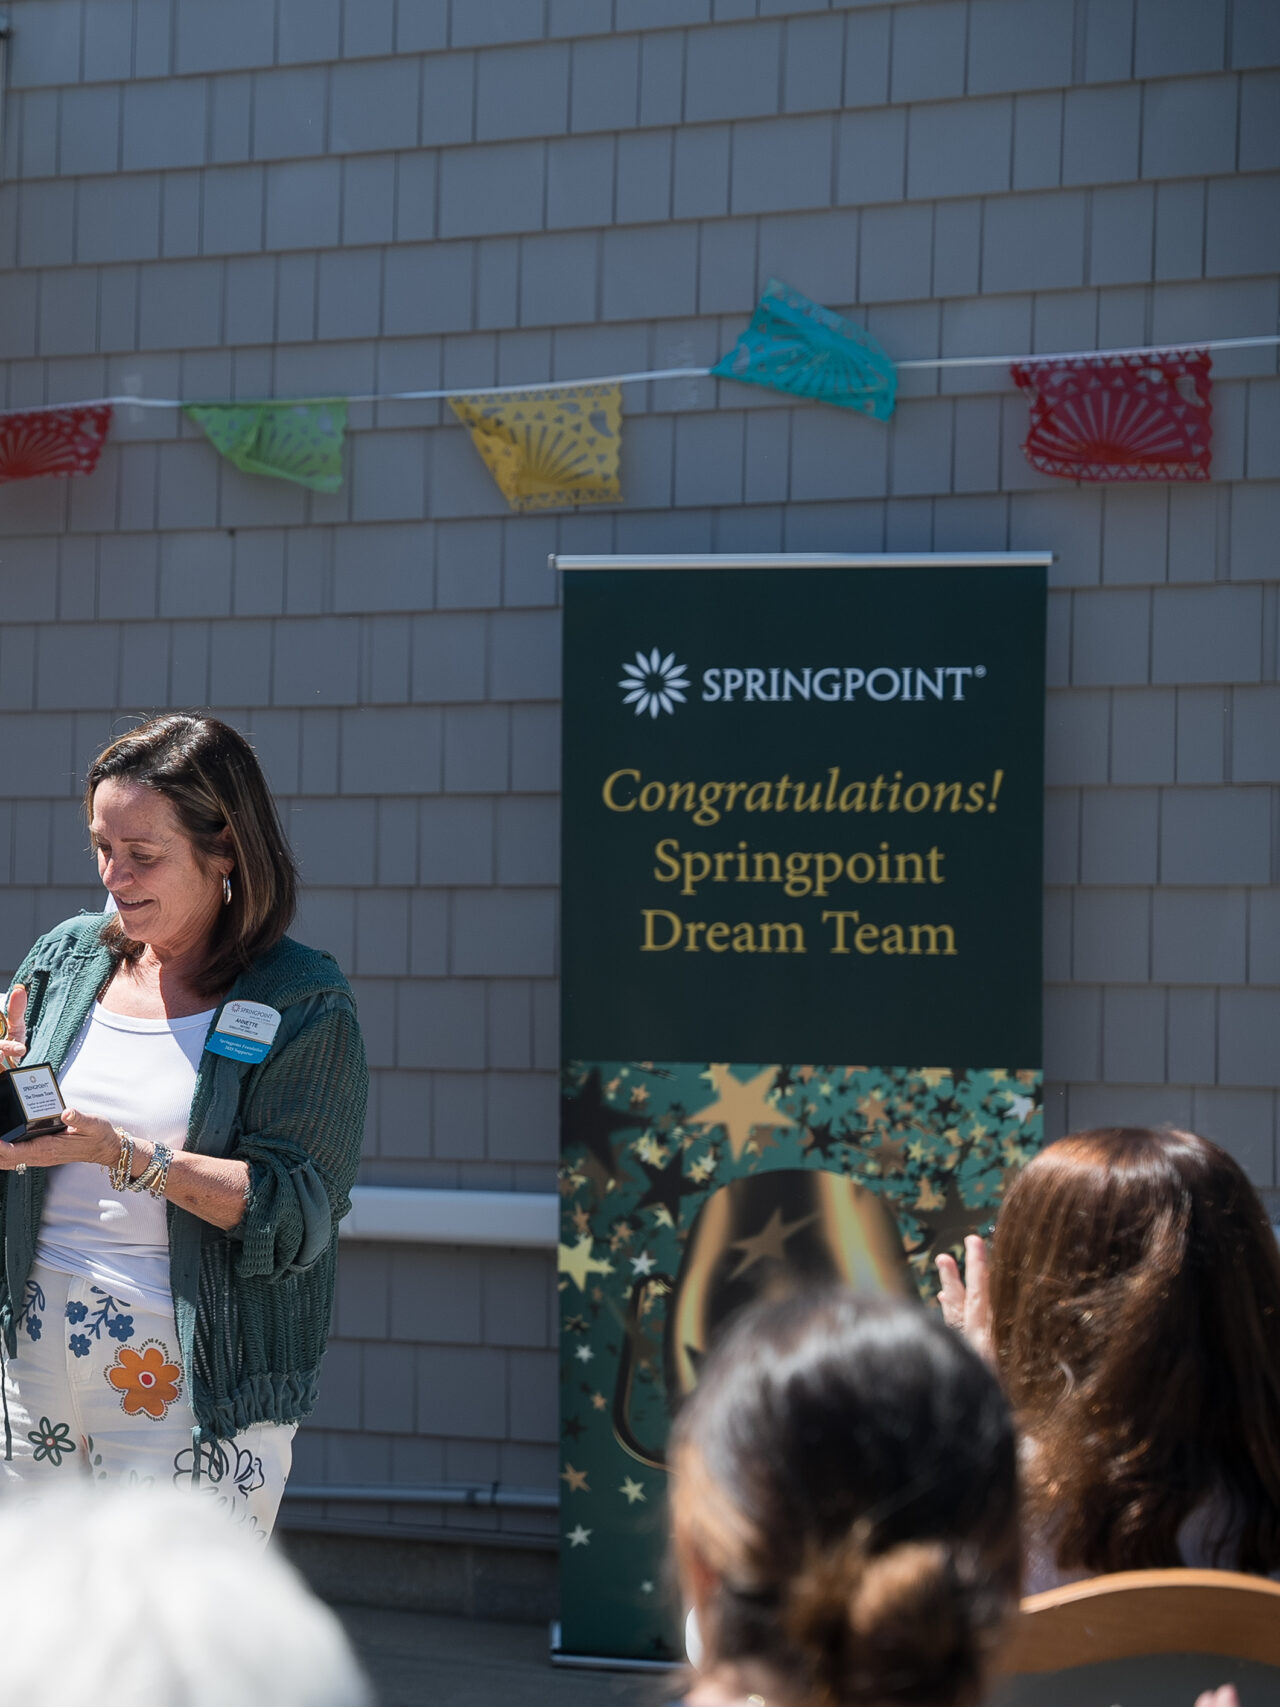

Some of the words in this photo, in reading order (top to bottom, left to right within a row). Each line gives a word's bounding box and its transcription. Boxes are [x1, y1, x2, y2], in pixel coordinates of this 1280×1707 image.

[603, 767, 1003, 826] Congratulations!
[654, 839, 943, 897] Springpoint
[642, 910, 805, 952] Dream
[822, 911, 956, 954] Team
[235, 1018, 259, 1028] ANNETTE
[240, 1007, 274, 1020] SPRINGPOINT
